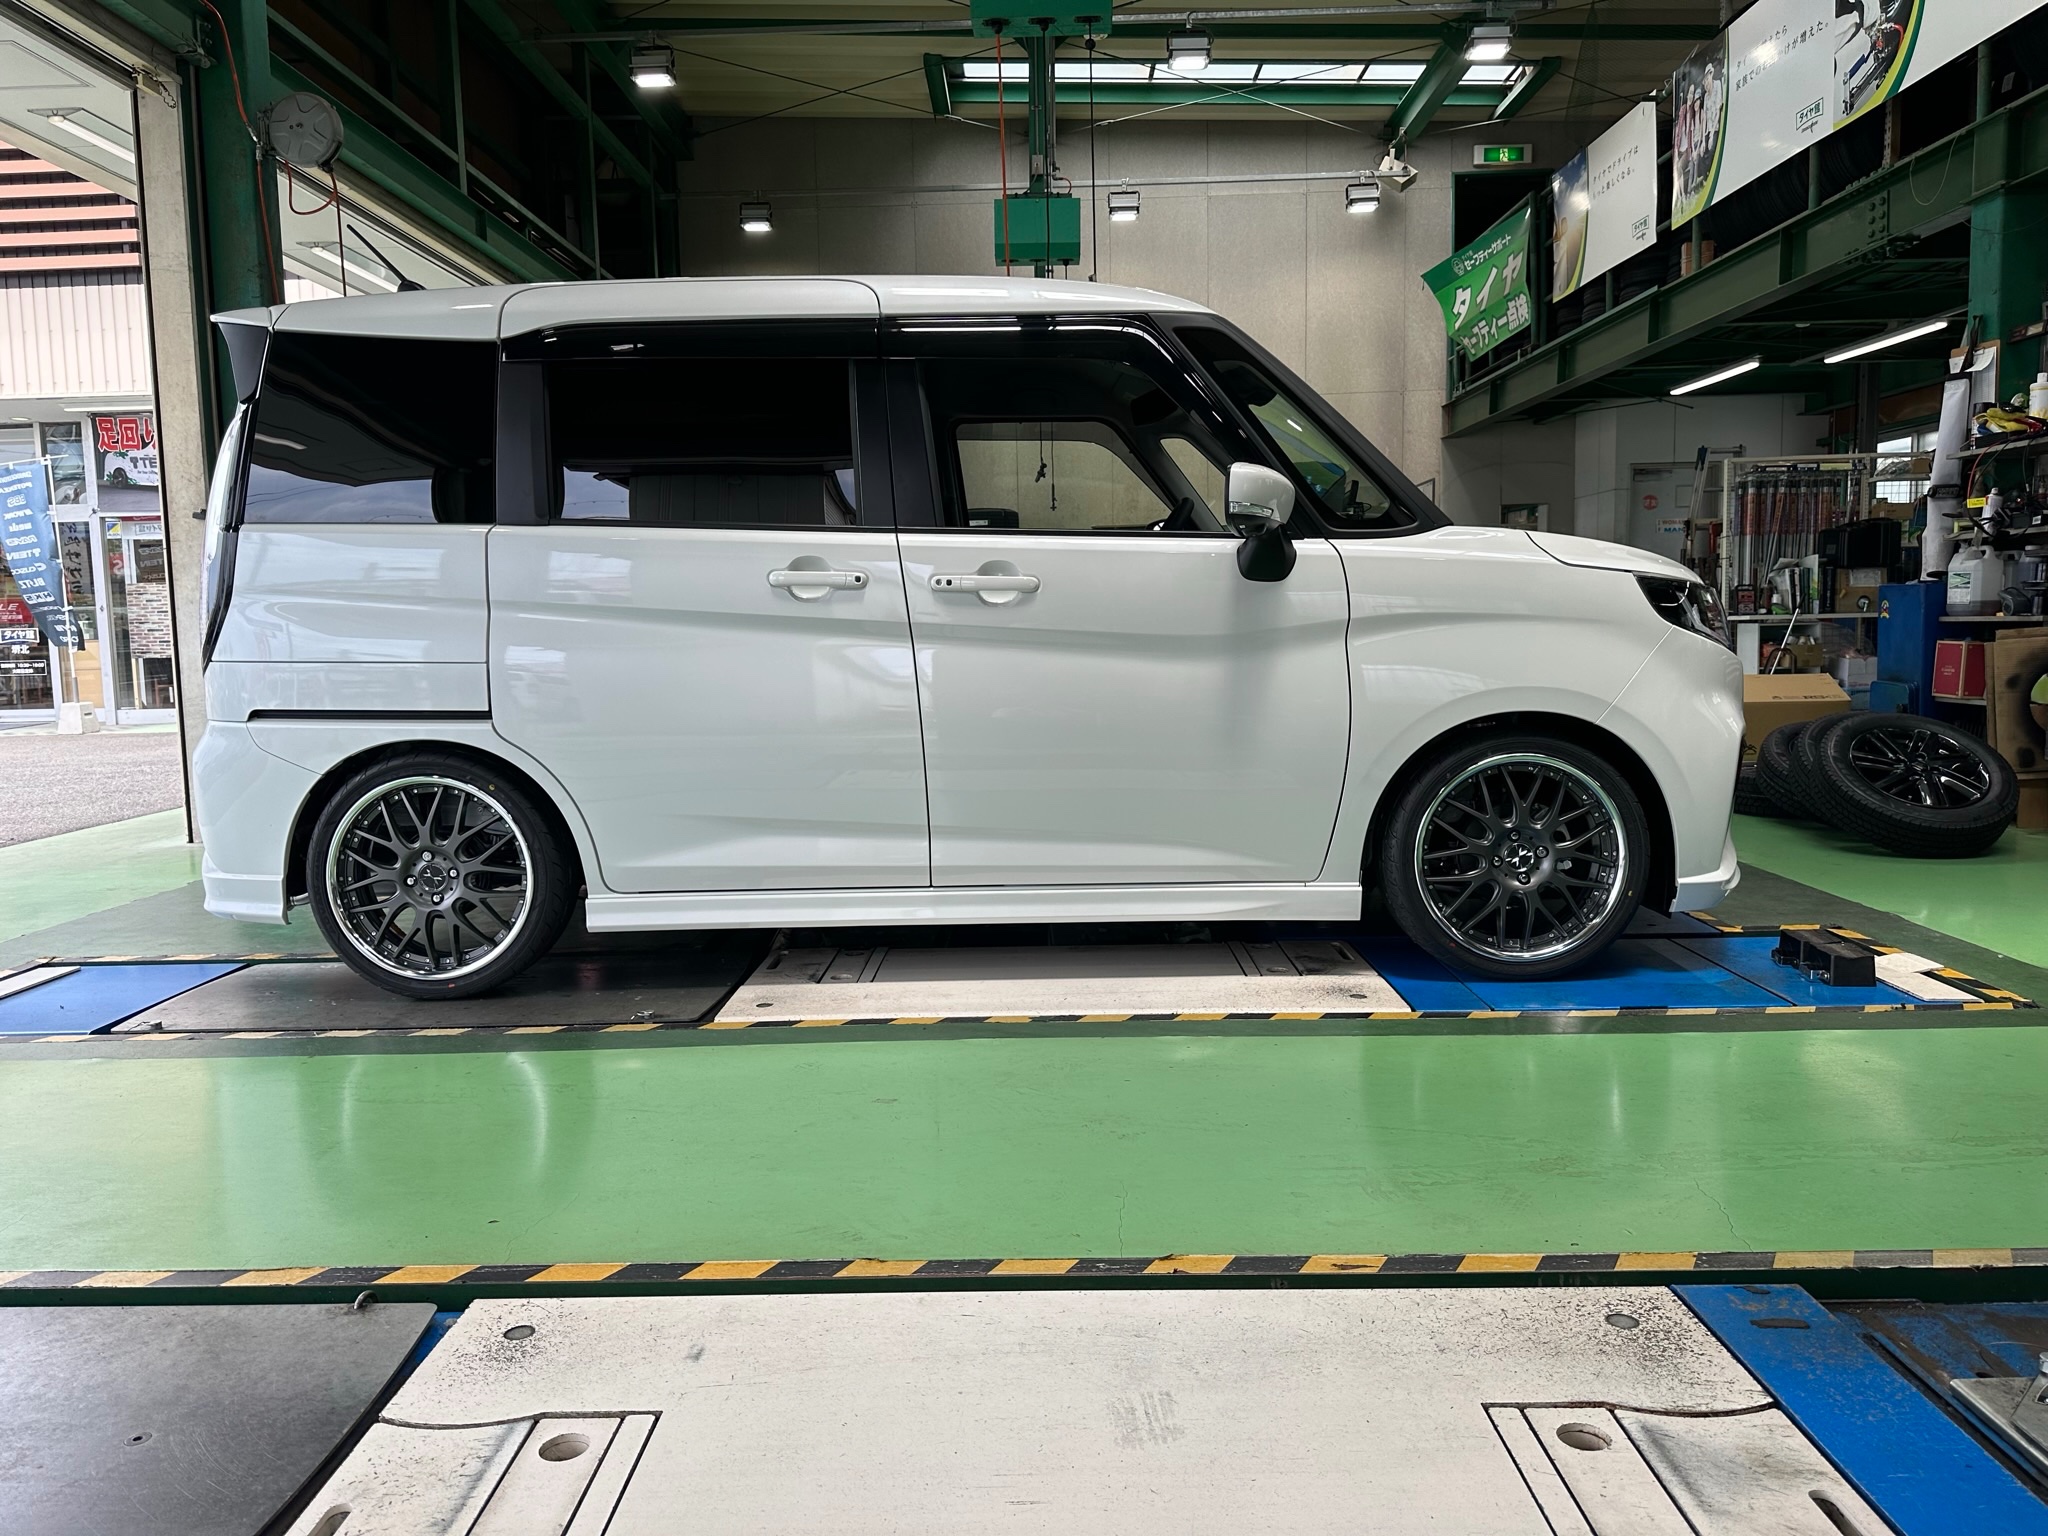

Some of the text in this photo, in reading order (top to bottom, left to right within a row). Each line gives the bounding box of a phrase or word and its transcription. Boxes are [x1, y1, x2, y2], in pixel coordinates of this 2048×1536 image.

[1464, 233, 1511, 270] セーフティーサポート
[1452, 251, 1523, 331] タイヤ
[1460, 293, 1529, 354] セーフティー点検
